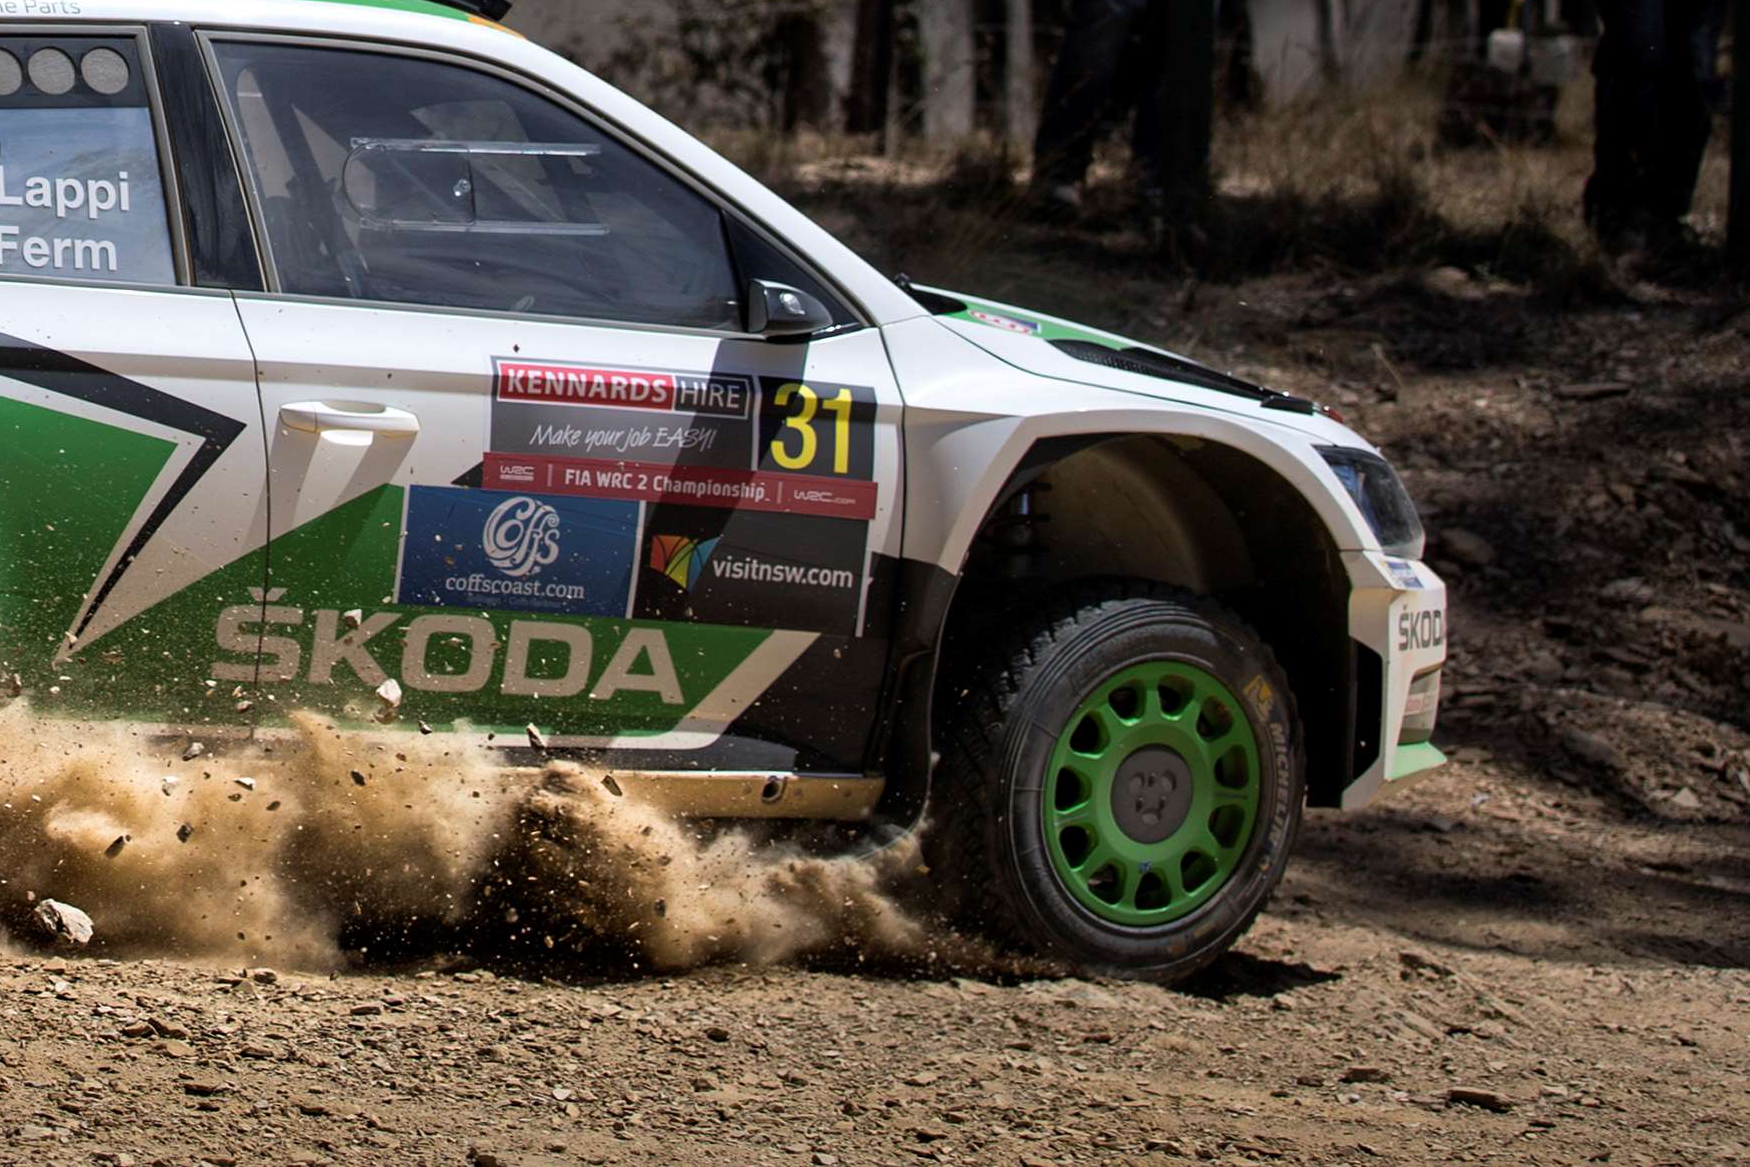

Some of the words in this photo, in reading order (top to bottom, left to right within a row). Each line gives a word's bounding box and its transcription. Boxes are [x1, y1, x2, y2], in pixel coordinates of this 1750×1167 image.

[505, 368, 669, 404] KENNARDS
[679, 378, 741, 409] HIRE
[529, 424, 578, 448] Make
[584, 428, 622, 452] your
[616, 425, 651, 452] job
[652, 426, 719, 452] EASY!
[769, 382, 853, 474] 31
[564, 468, 592, 486] FIA
[596, 471, 634, 490] WRC
[636, 474, 649, 491] 2
[652, 475, 766, 502] Championship
[445, 573, 586, 600] coffscoast.com
[712, 556, 854, 589] visitnsw.com
[210, 587, 684, 704] ŠKODA
[1398, 604, 1445, 652] ŠKOD
[1269, 722, 1290, 847] MICHELIN
